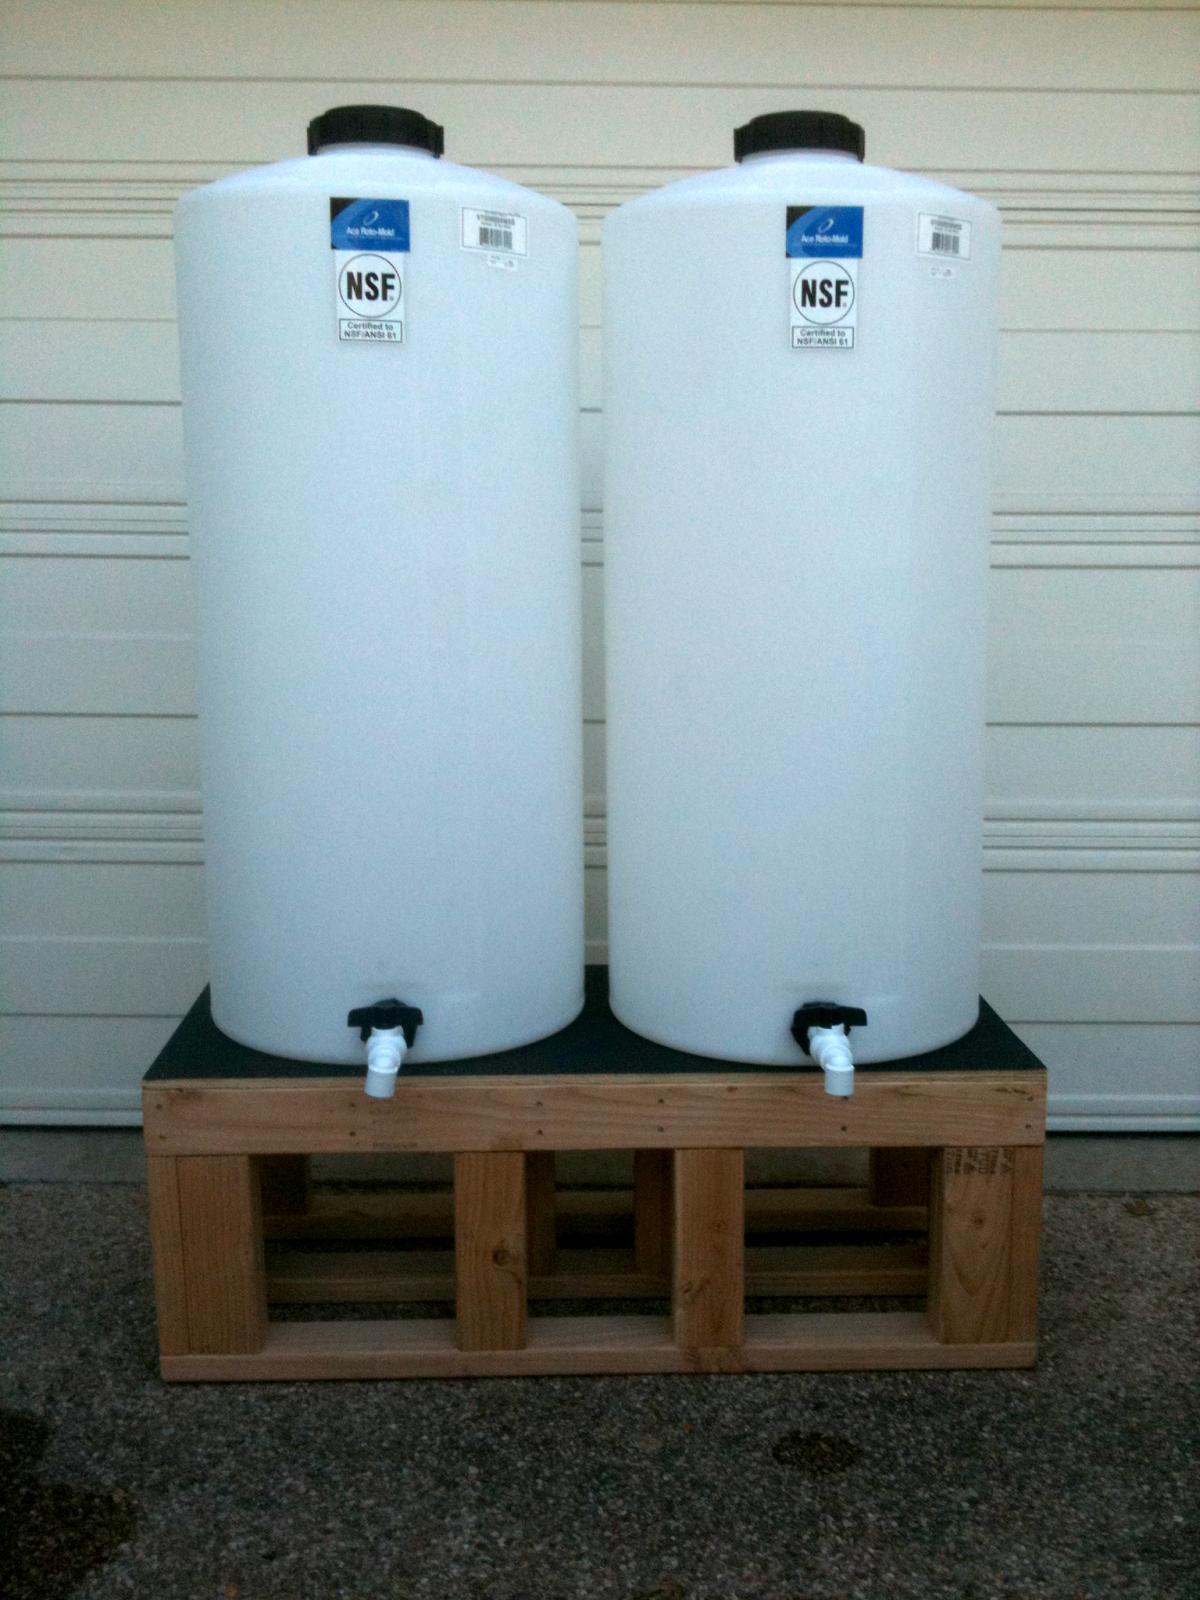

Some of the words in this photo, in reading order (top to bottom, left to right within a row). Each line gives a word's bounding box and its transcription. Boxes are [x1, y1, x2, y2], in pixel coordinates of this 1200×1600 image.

[347, 271, 396, 301] NSF
[801, 279, 850, 308] NSF
[347, 321, 383, 331] Certified
[385, 323, 394, 331] to
[387, 331, 397, 340] 61
[800, 328, 836, 337] Certified
[837, 329, 846, 338] to
[838, 337, 848, 347] 61
